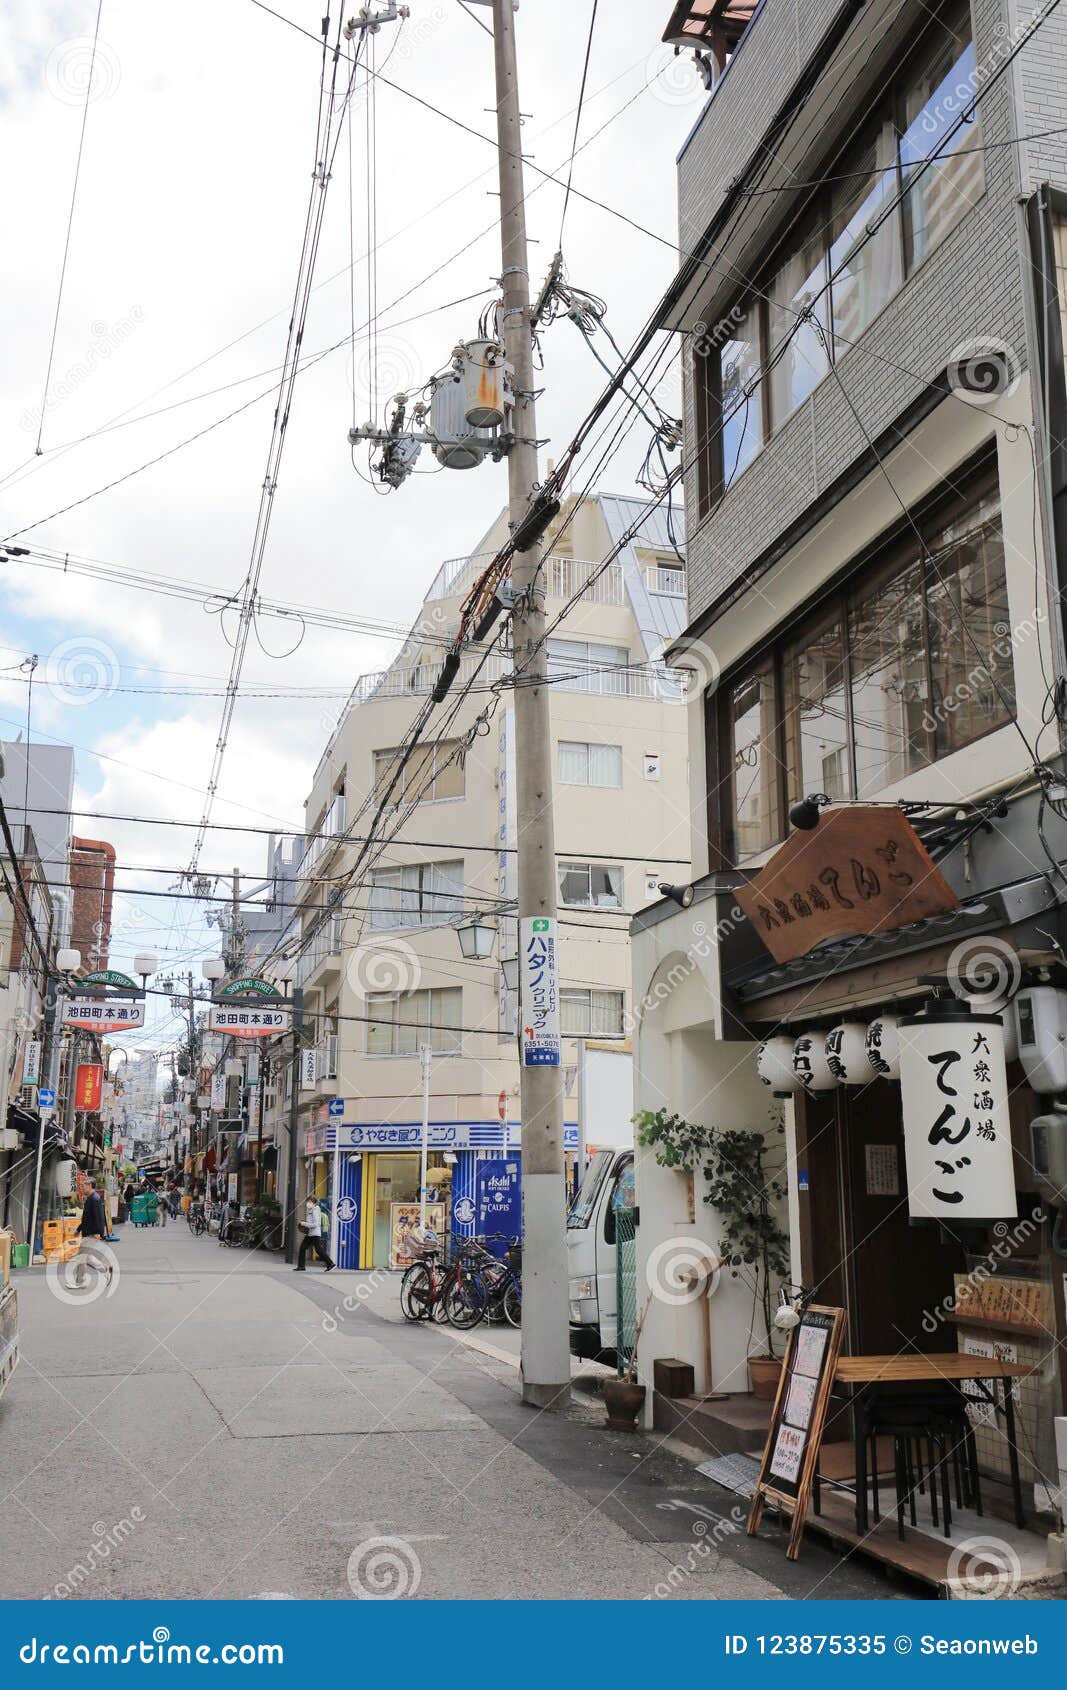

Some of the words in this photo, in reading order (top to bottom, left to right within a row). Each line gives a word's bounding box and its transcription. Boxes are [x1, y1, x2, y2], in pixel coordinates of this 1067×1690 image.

[227, 979, 253, 994] SHOPPING
[254, 981, 275, 995] STREET
[527, 936, 548, 1029] ハタノクリニック
[67, 1006, 140, 1020] 池田町本通り
[215, 1013, 283, 1025] 池田町本通り
[971, 1032, 997, 1143] 大衆酒場
[927, 1050, 972, 1204] てんご
[487, 1175, 510, 1187] Asahi
[487, 1203, 510, 1213] CALPIS
